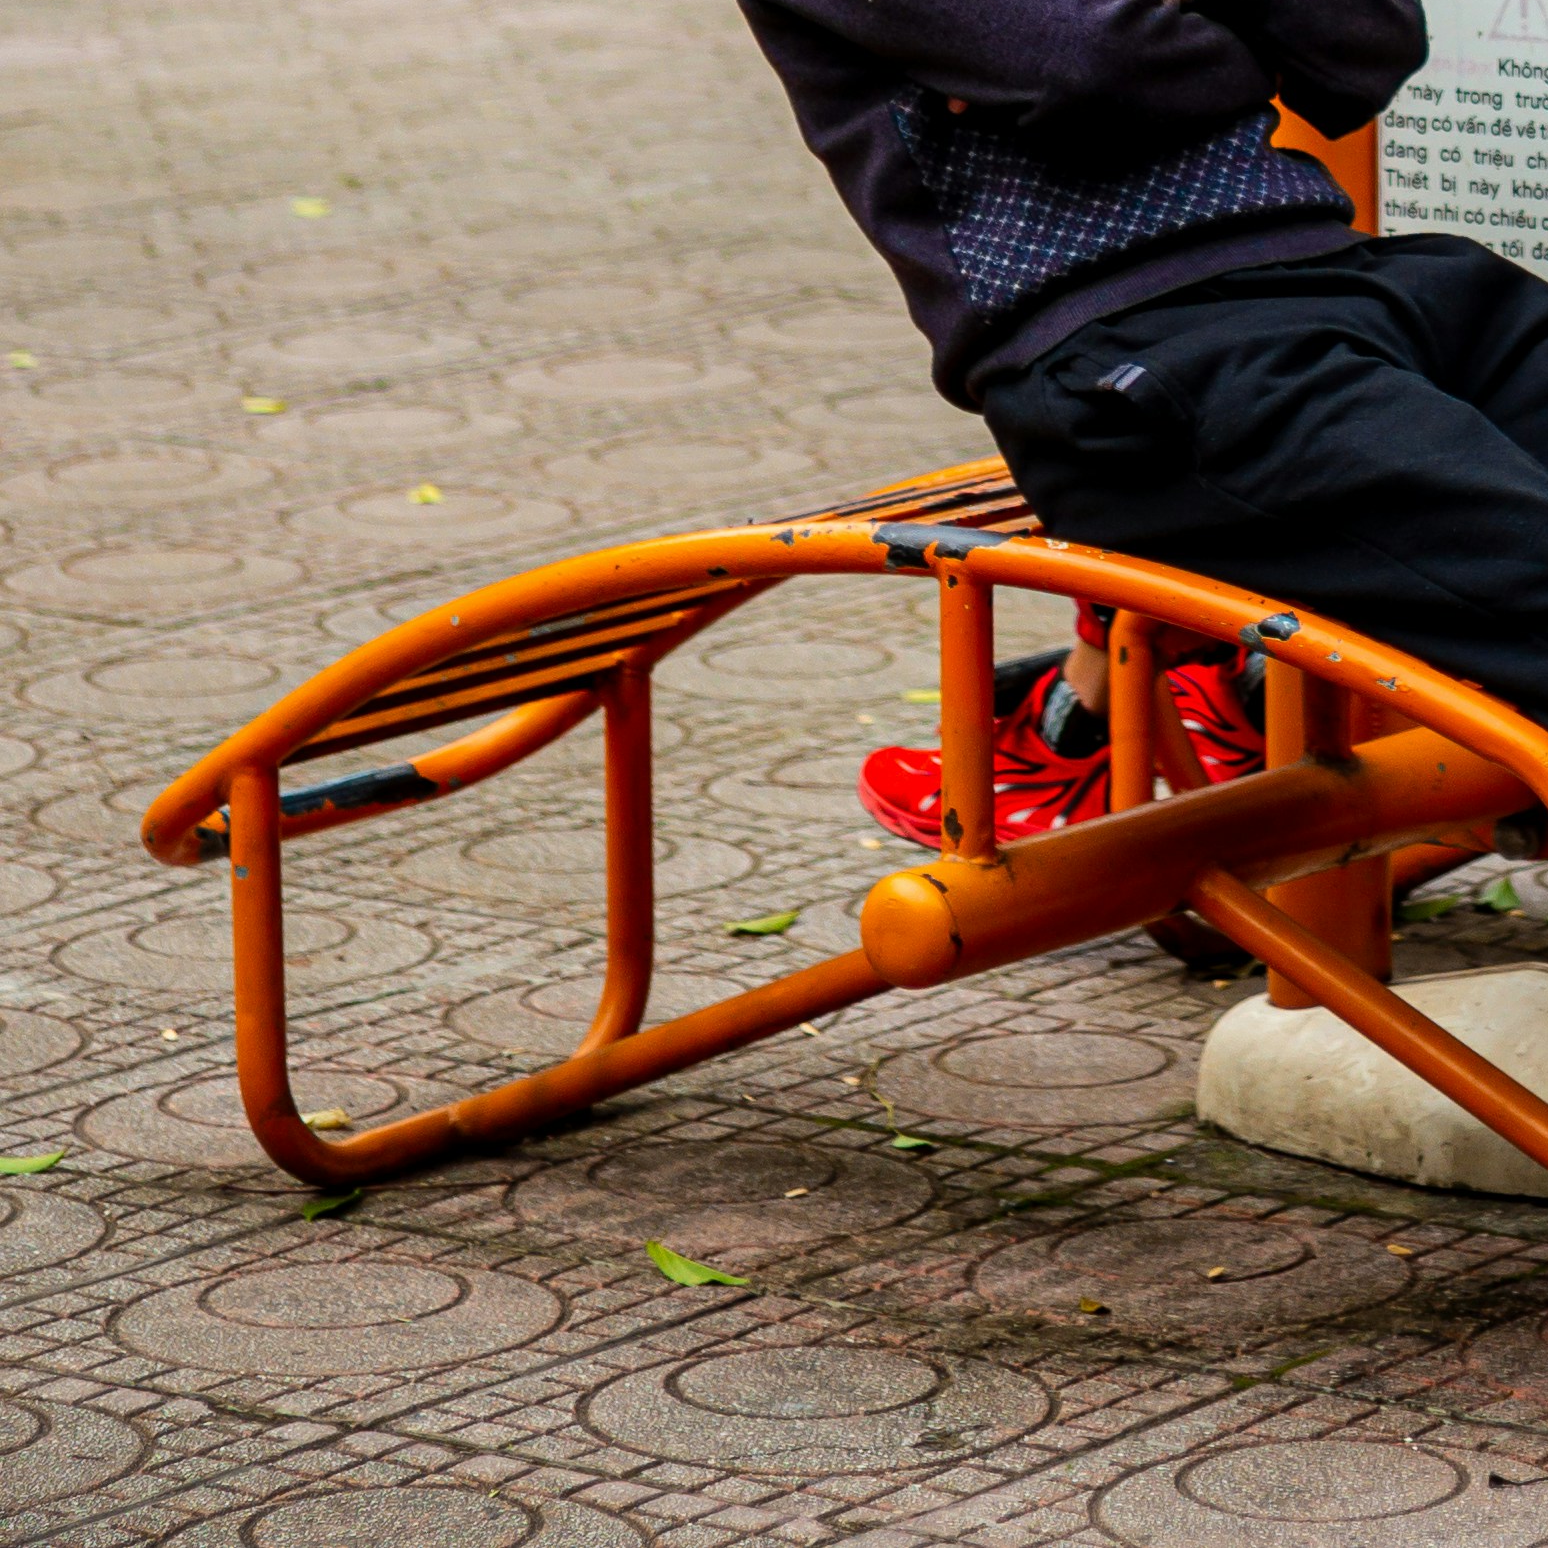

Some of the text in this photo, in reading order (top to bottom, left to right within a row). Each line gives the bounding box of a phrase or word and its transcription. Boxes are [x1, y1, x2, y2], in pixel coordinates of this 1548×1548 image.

[1413, 84, 1443, 105] này
[1455, 87, 1503, 111] trong
[1384, 110, 1427, 135] đang
[1431, 116, 1452, 132] có
[1455, 116, 1486, 135] vấn
[1490, 118, 1512, 137] đề
[1516, 120, 1536, 139] về
[1384, 139, 1428, 164] đang
[1440, 146, 1461, 163] có
[1473, 148, 1514, 170] triệu
[1384, 168, 1428, 190] Thiết
[1441, 173, 1456, 195] bị
[1469, 179, 1500, 200] này
[1434, 203, 1458, 222] nhi
[1464, 208, 1485, 225] có
[1489, 208, 1536, 229] chiều
[1501, 240, 1523, 258] tối
